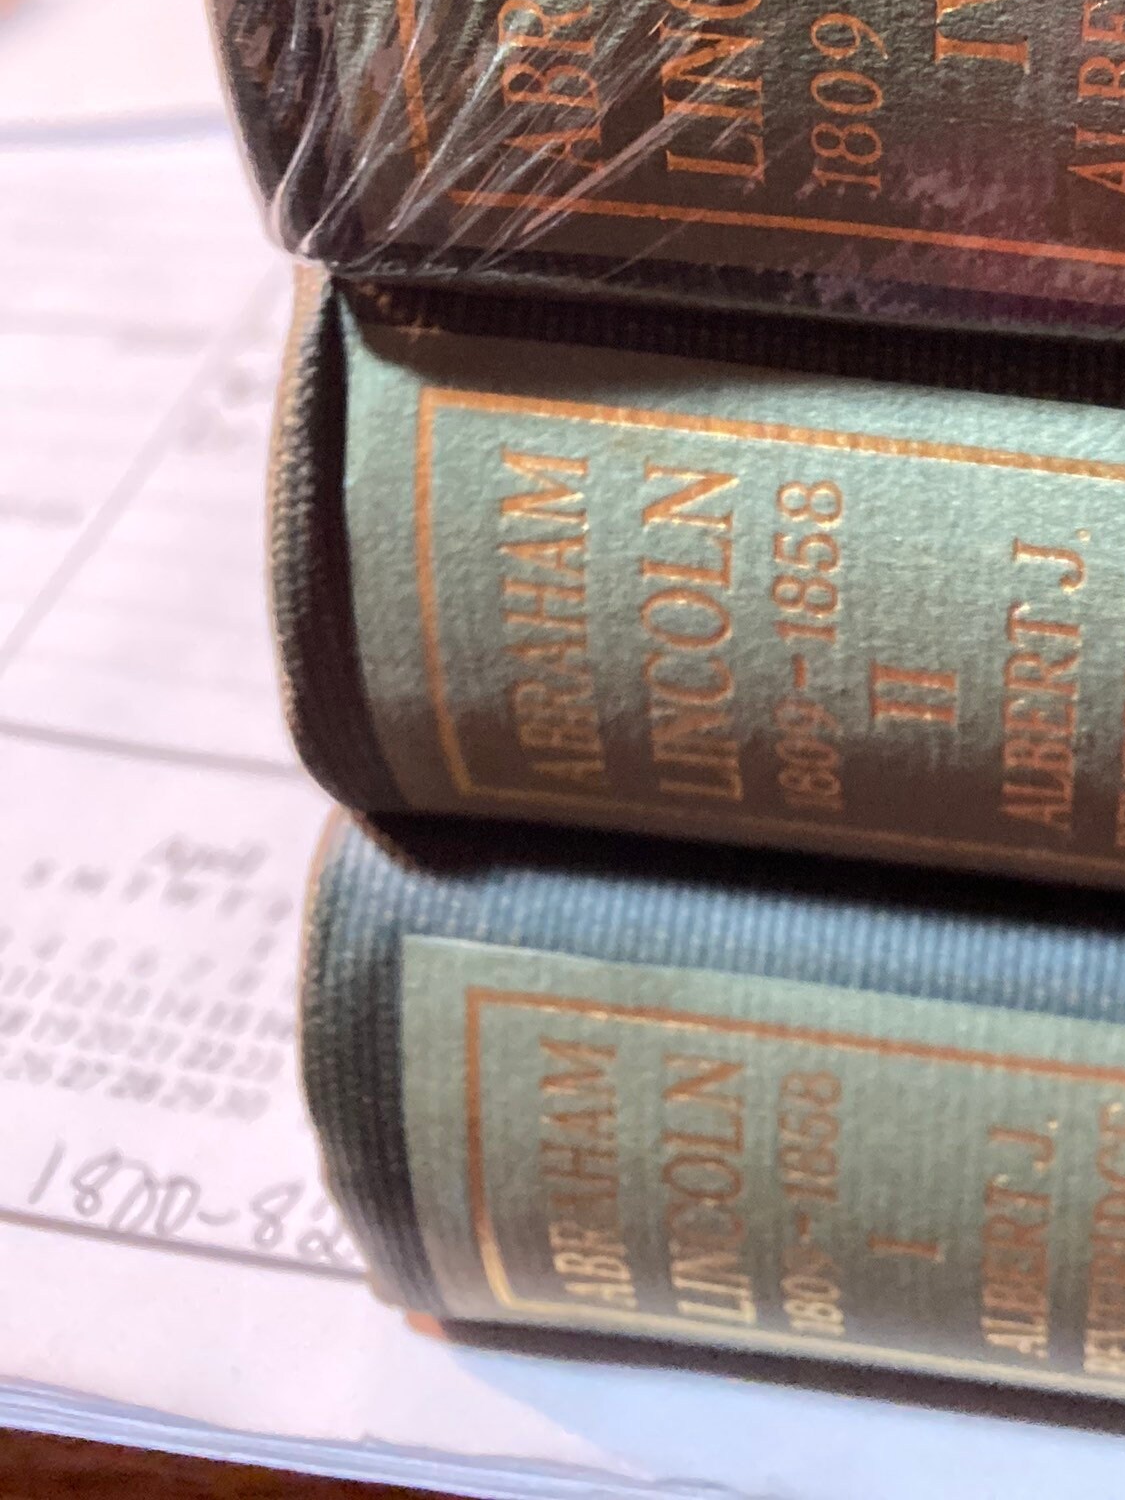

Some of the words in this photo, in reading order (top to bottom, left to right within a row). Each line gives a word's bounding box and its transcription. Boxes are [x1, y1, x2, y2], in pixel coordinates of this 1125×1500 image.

[498, 447, 604, 783] ABRAHAM
[641, 459, 742, 801] LINCOLN
[1012, 529, 1091, 593] J.
[869, 660, 958, 729] II
[1000, 601, 1082, 832] ALBERT
[540, 1035, 635, 1309] ABRAHAM
[662, 1053, 756, 1325] LINCOLN
[988, 1119, 1057, 1171] J.
[980, 1175, 1052, 1360] ALBERT
